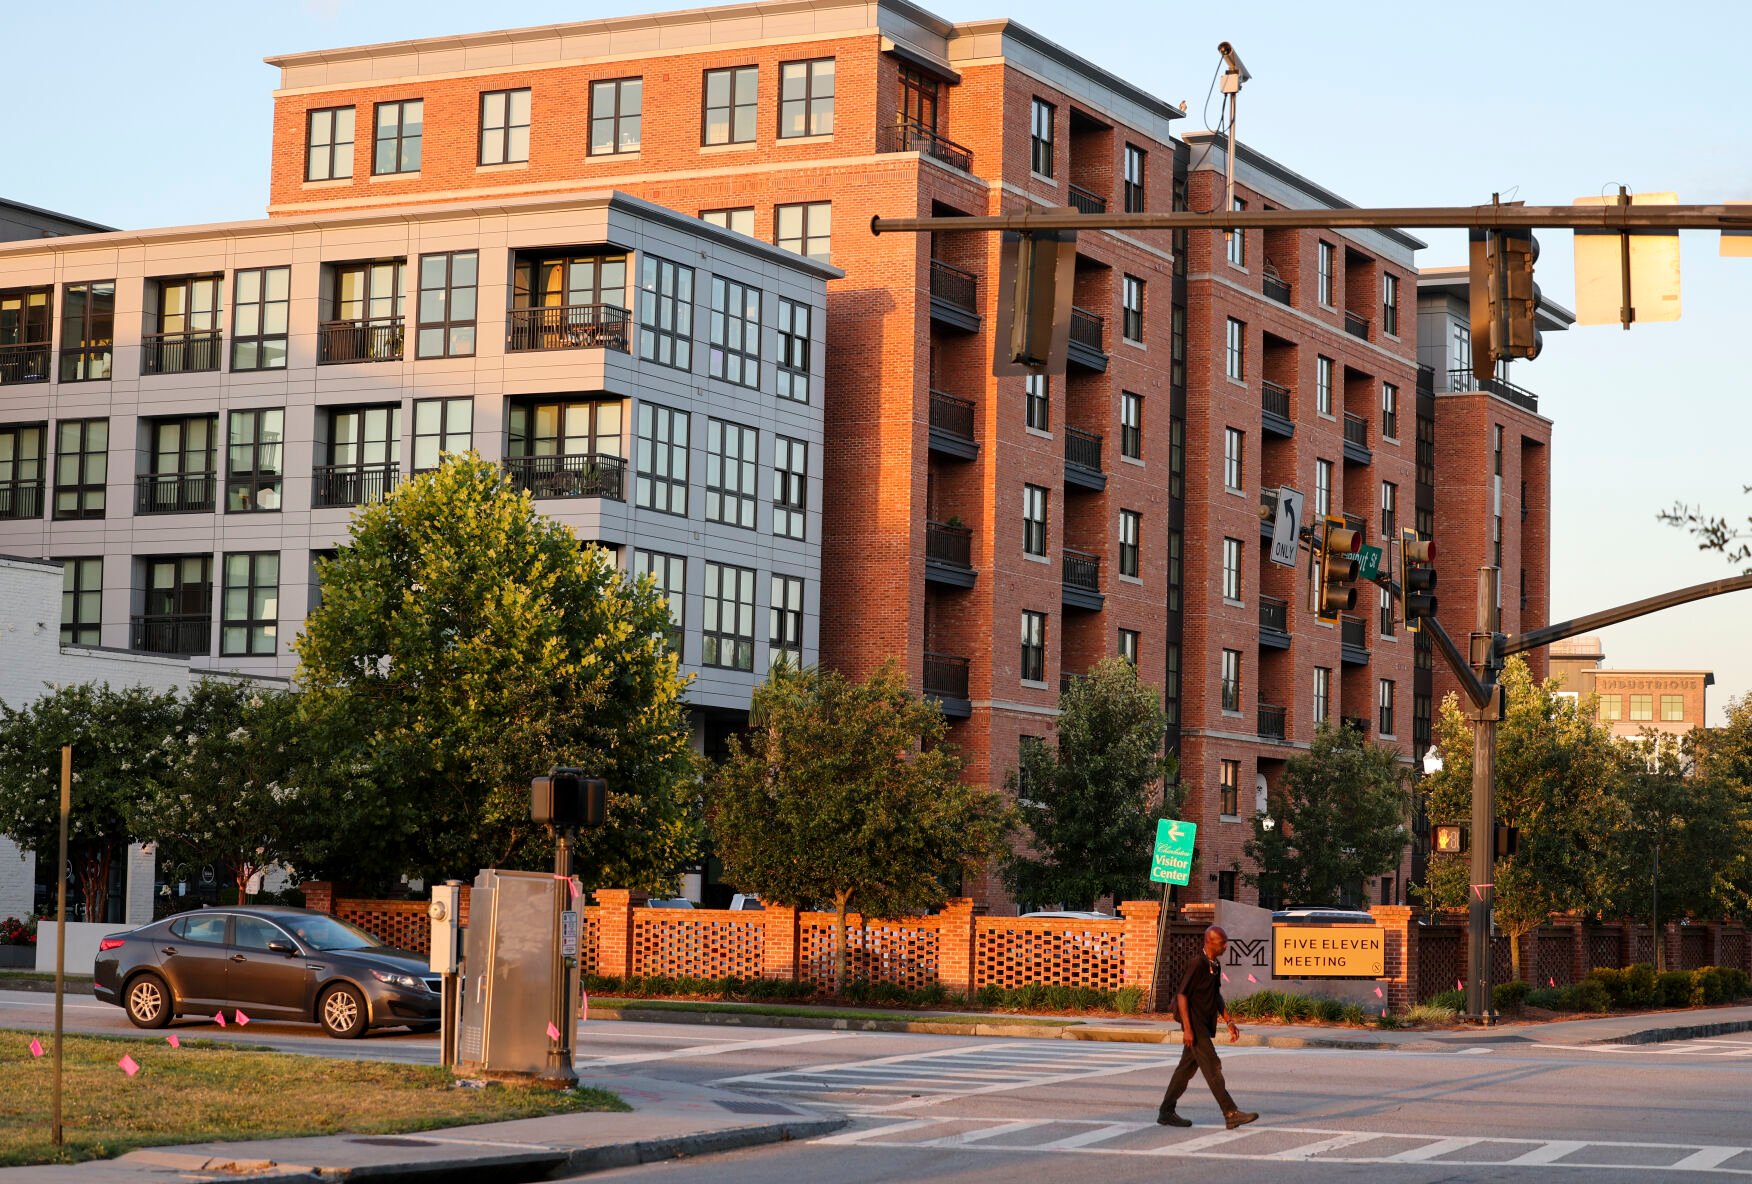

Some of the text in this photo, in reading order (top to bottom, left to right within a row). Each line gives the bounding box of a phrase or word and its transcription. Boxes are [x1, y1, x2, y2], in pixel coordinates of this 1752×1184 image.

[1276, 542, 1294, 560] ONLY
[1369, 552, 1378, 568] St
[1603, 680, 1697, 690] INDUSTRIOUS
[1155, 854, 1188, 868] Visitor
[1153, 866, 1187, 880] Center
[1284, 939, 1379, 949] FIVE ELEVEN
[1284, 956, 1346, 966] MEETING
